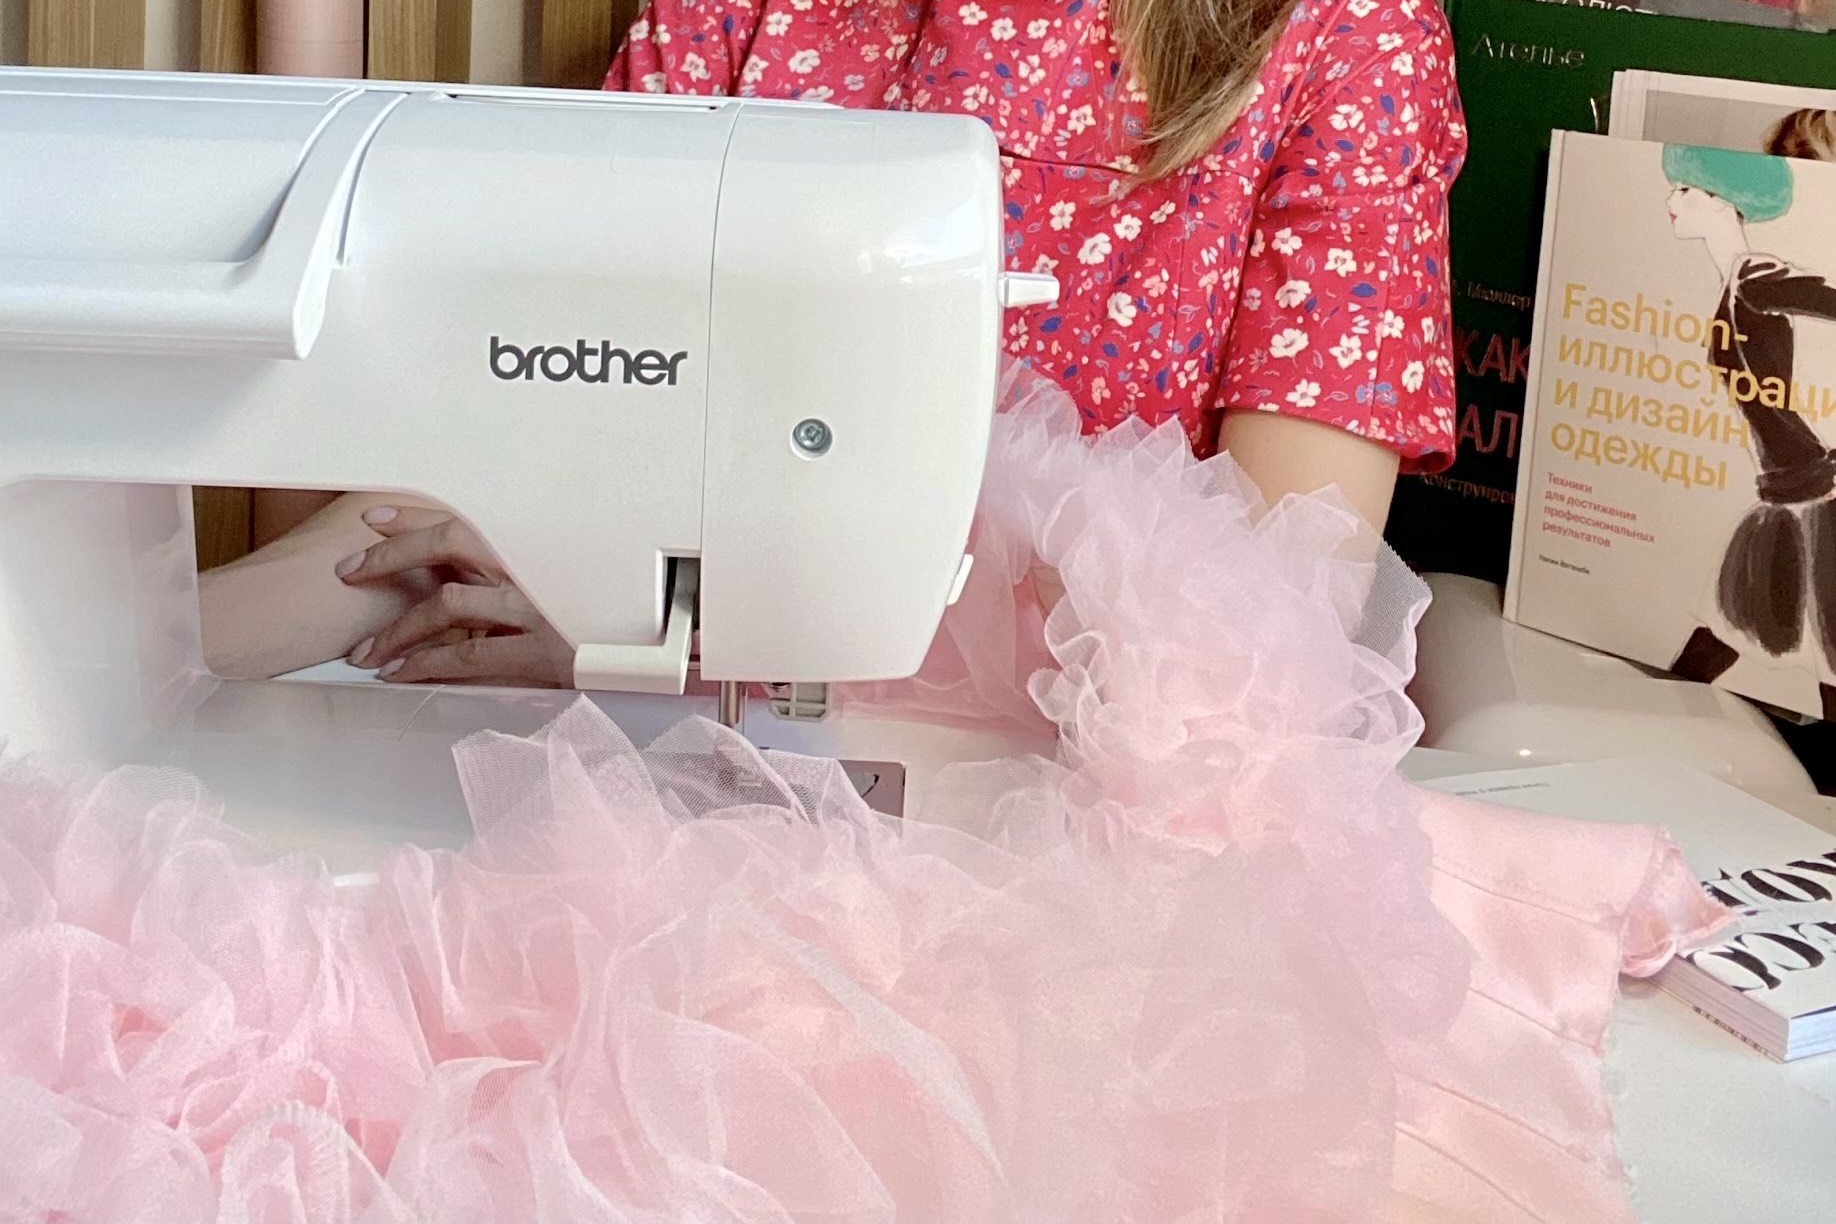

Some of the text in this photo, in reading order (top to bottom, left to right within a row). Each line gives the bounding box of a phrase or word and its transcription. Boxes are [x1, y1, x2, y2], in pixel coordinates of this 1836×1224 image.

[1563, 282, 1748, 350] Fashion-
[490, 336, 688, 385] brother
[1554, 378, 1748, 449] и дизайн
[1551, 423, 1728, 489] одежды
[1548, 472, 1593, 494] Техники
[1543, 506, 1655, 544] профессиональных
[1545, 490, 1637, 521] для достижения
[1542, 522, 1611, 548] результатов
